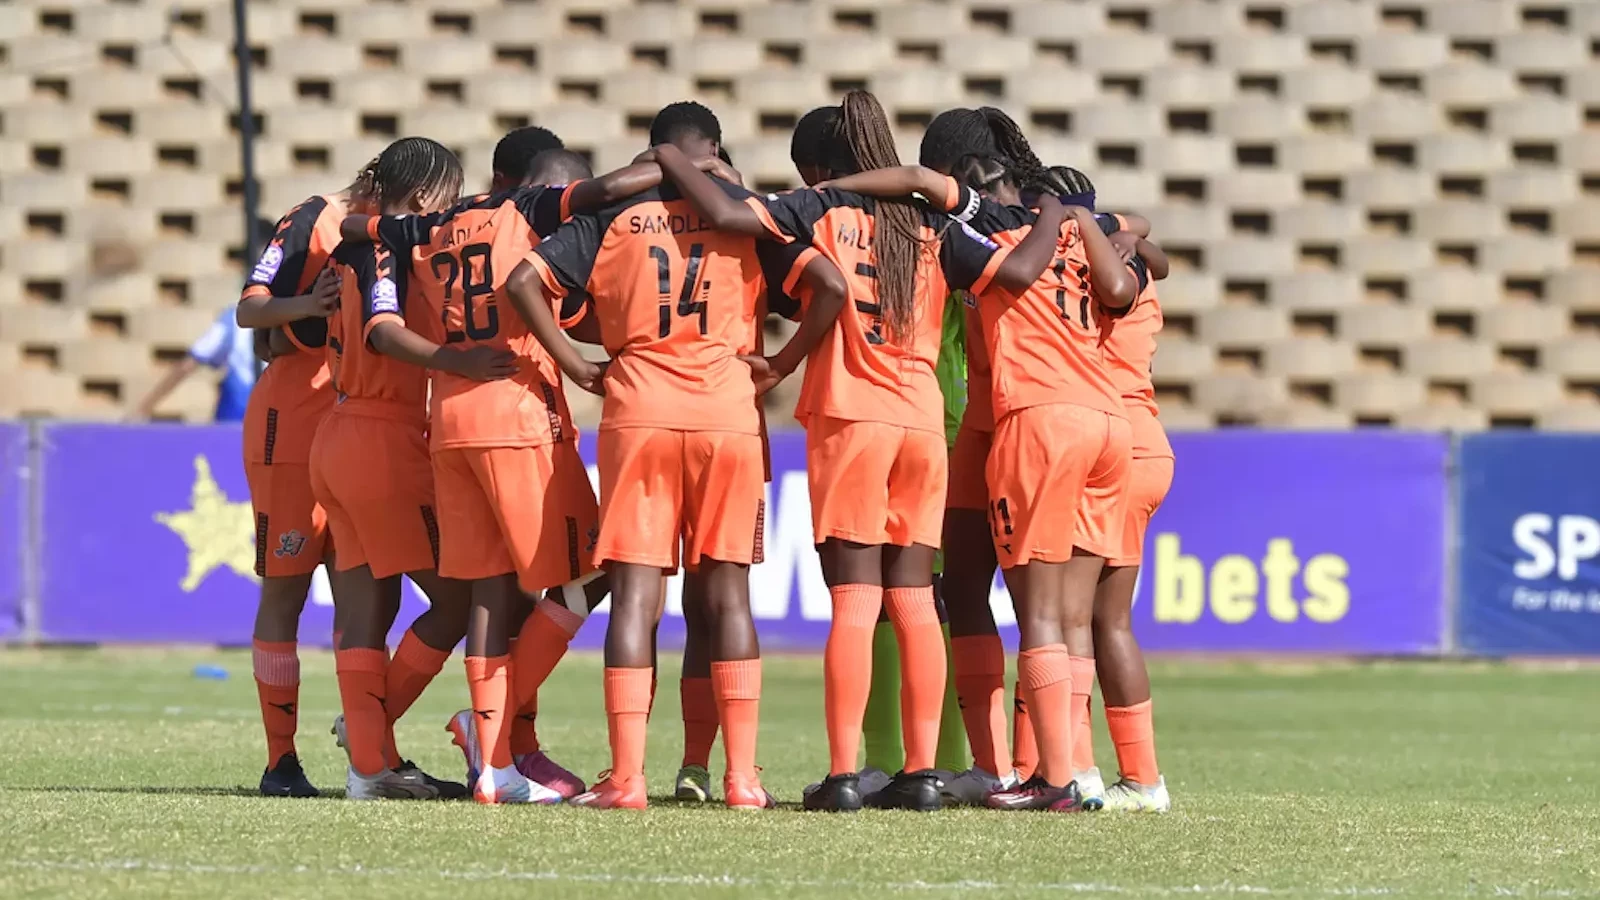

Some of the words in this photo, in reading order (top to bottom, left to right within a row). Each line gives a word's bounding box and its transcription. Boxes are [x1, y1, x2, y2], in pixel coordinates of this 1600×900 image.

[431, 242, 499, 344] 28
[648, 242, 711, 339] 14
[1154, 532, 1351, 624] bets
